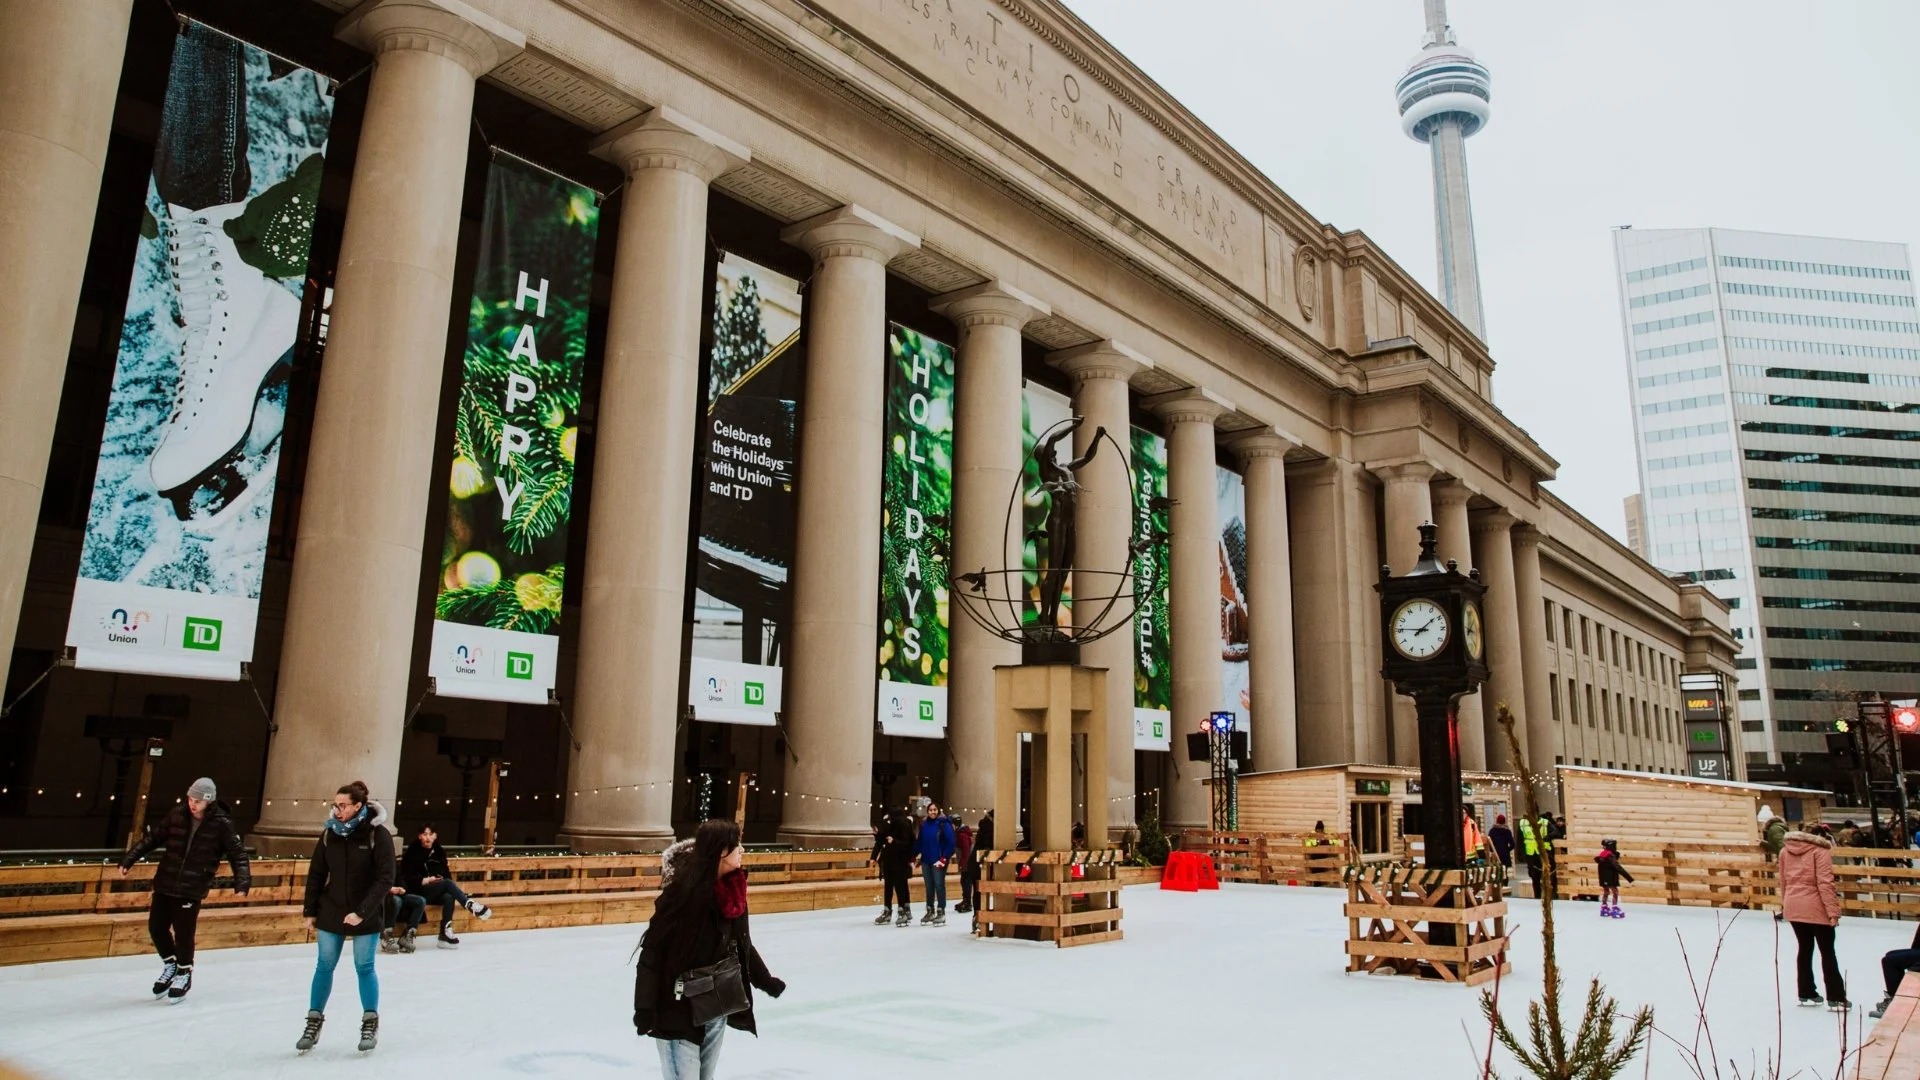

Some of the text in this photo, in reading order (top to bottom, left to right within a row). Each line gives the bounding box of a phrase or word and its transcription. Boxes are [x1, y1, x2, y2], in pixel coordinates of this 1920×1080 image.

[945, 0, 1122, 138] TION
[950, 22, 1033, 92] RAILWAY
[1050, 96, 1122, 157] COMPANY
[1167, 180, 1230, 239] TRUNK
[1158, 193, 1239, 257] RAILWAY
[494, 270, 549, 521] HAPPY
[713, 420, 772, 448] Celebrate
[712, 440, 784, 471] the Holidays
[711, 461, 772, 487] with Union
[709, 482, 753, 501] and TD
[902, 354, 931, 661] HOLIDAYS
[108, 622, 218, 645] Union TD
[455, 656, 531, 675] Union TD
[745, 685, 763, 701] TD
[920, 703, 933, 717] TD
[1698, 759, 1717, 771] UP
